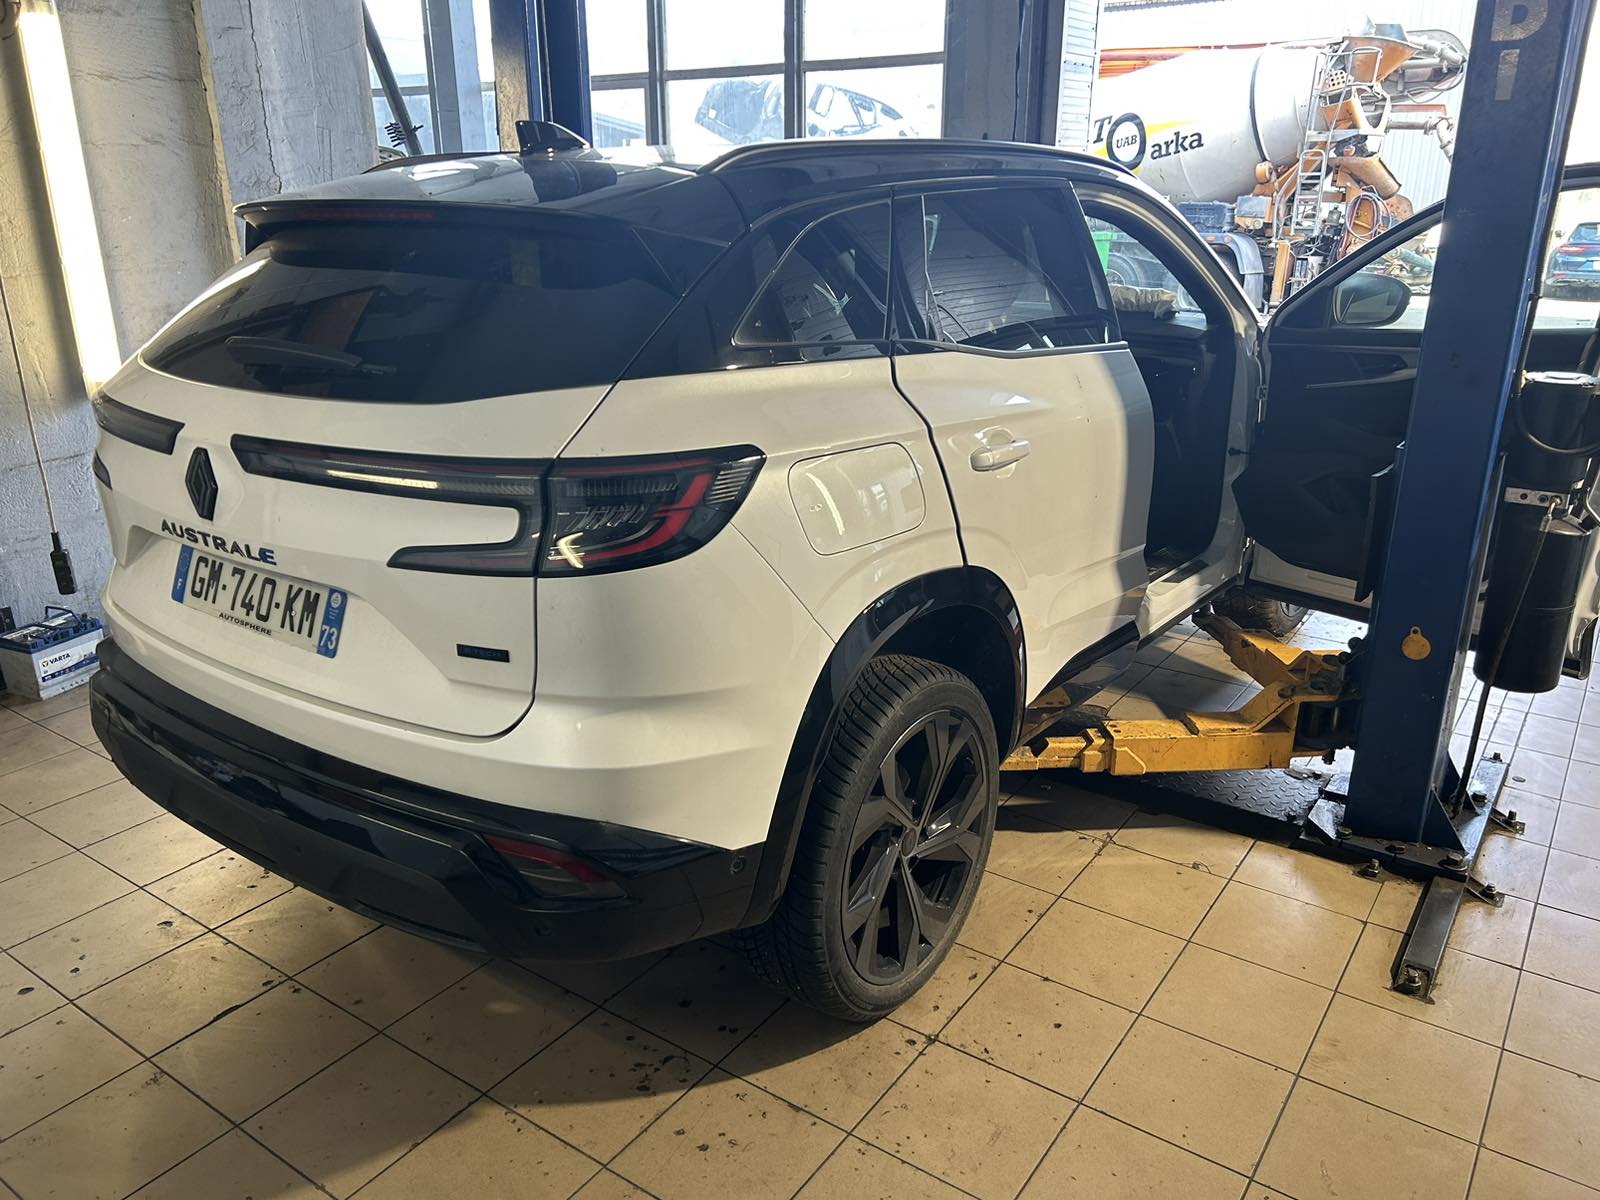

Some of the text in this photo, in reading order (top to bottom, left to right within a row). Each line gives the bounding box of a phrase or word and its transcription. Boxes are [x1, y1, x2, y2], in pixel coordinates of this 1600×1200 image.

[1116, 134, 1138, 149] UAB
[161, 519, 277, 565] AUSTRALE
[218, 612, 272, 636] AUTOSPHERE
[320, 625, 338, 650] 73
[49, 653, 71, 664] VARTA
